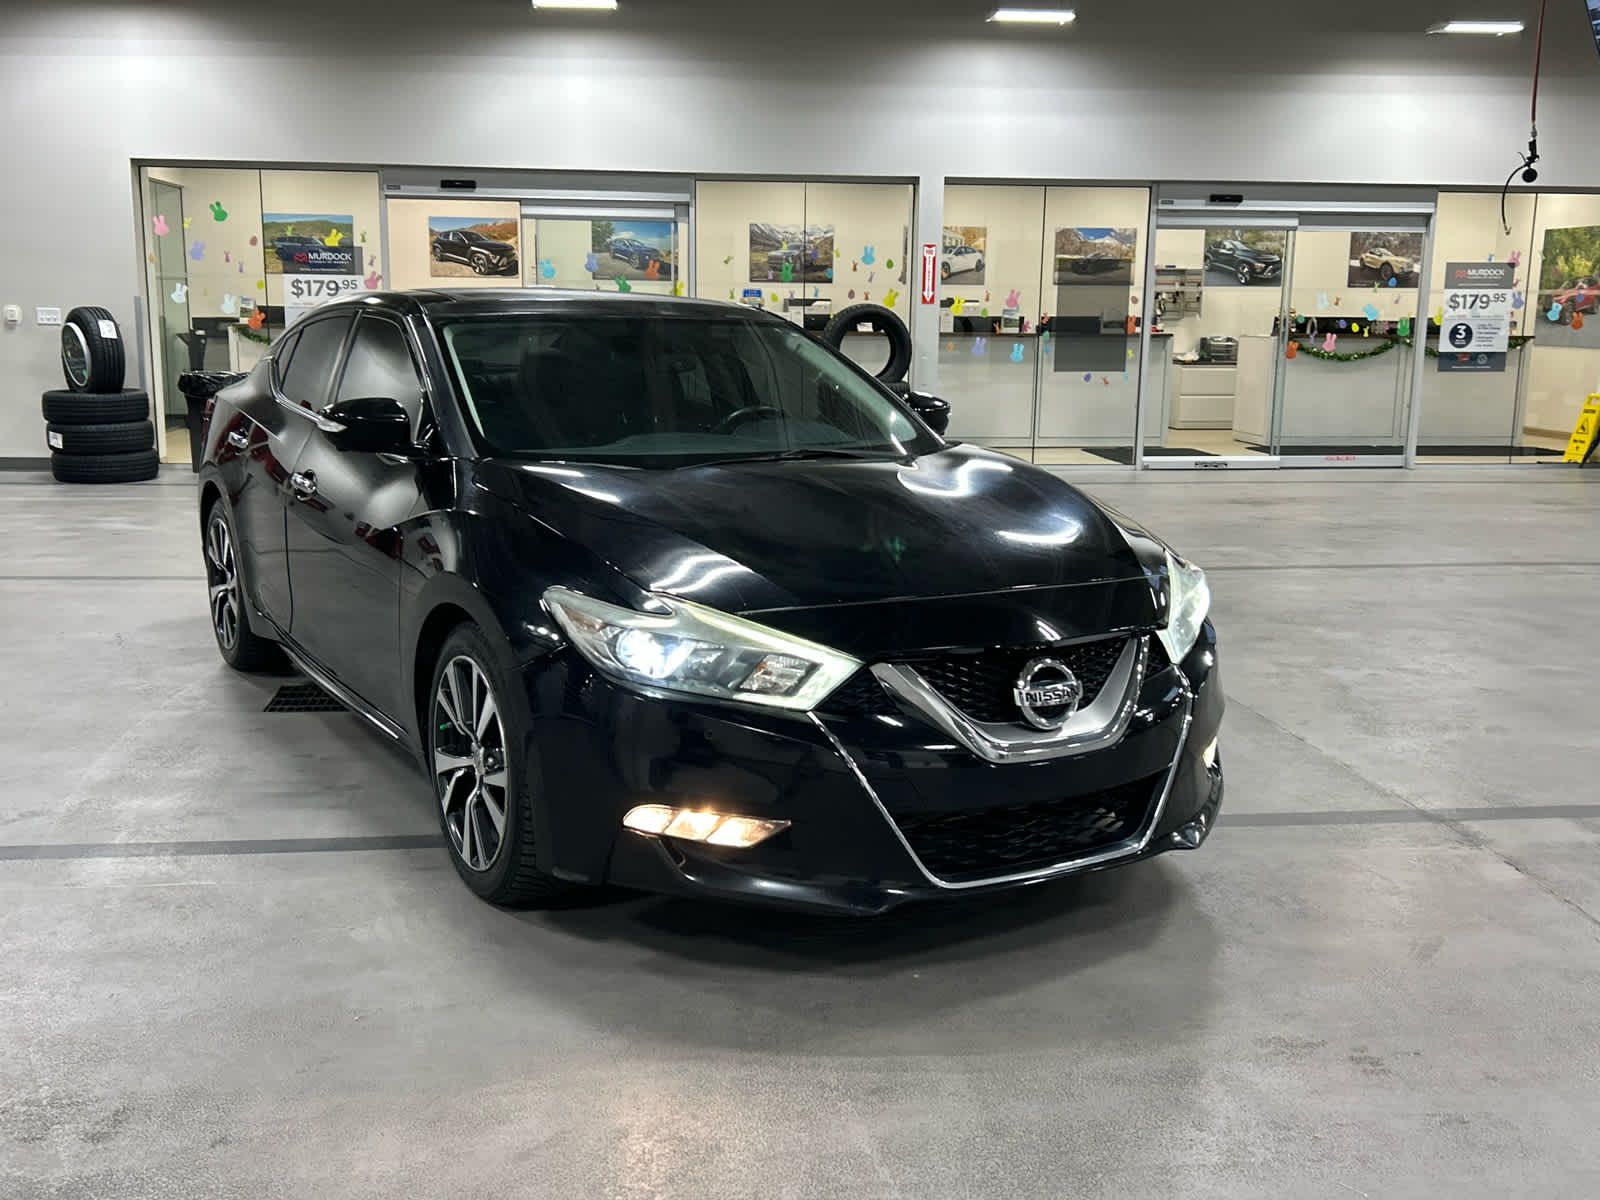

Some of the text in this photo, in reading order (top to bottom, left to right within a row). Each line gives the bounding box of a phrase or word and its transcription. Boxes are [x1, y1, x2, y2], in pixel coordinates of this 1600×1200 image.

[308, 252, 352, 261] MURDOCK
[291, 278, 358, 298] $179.95
[1449, 293, 1506, 311] $179.95
[1455, 325, 1467, 339] 3
[1025, 687, 1079, 703] NISSAN
